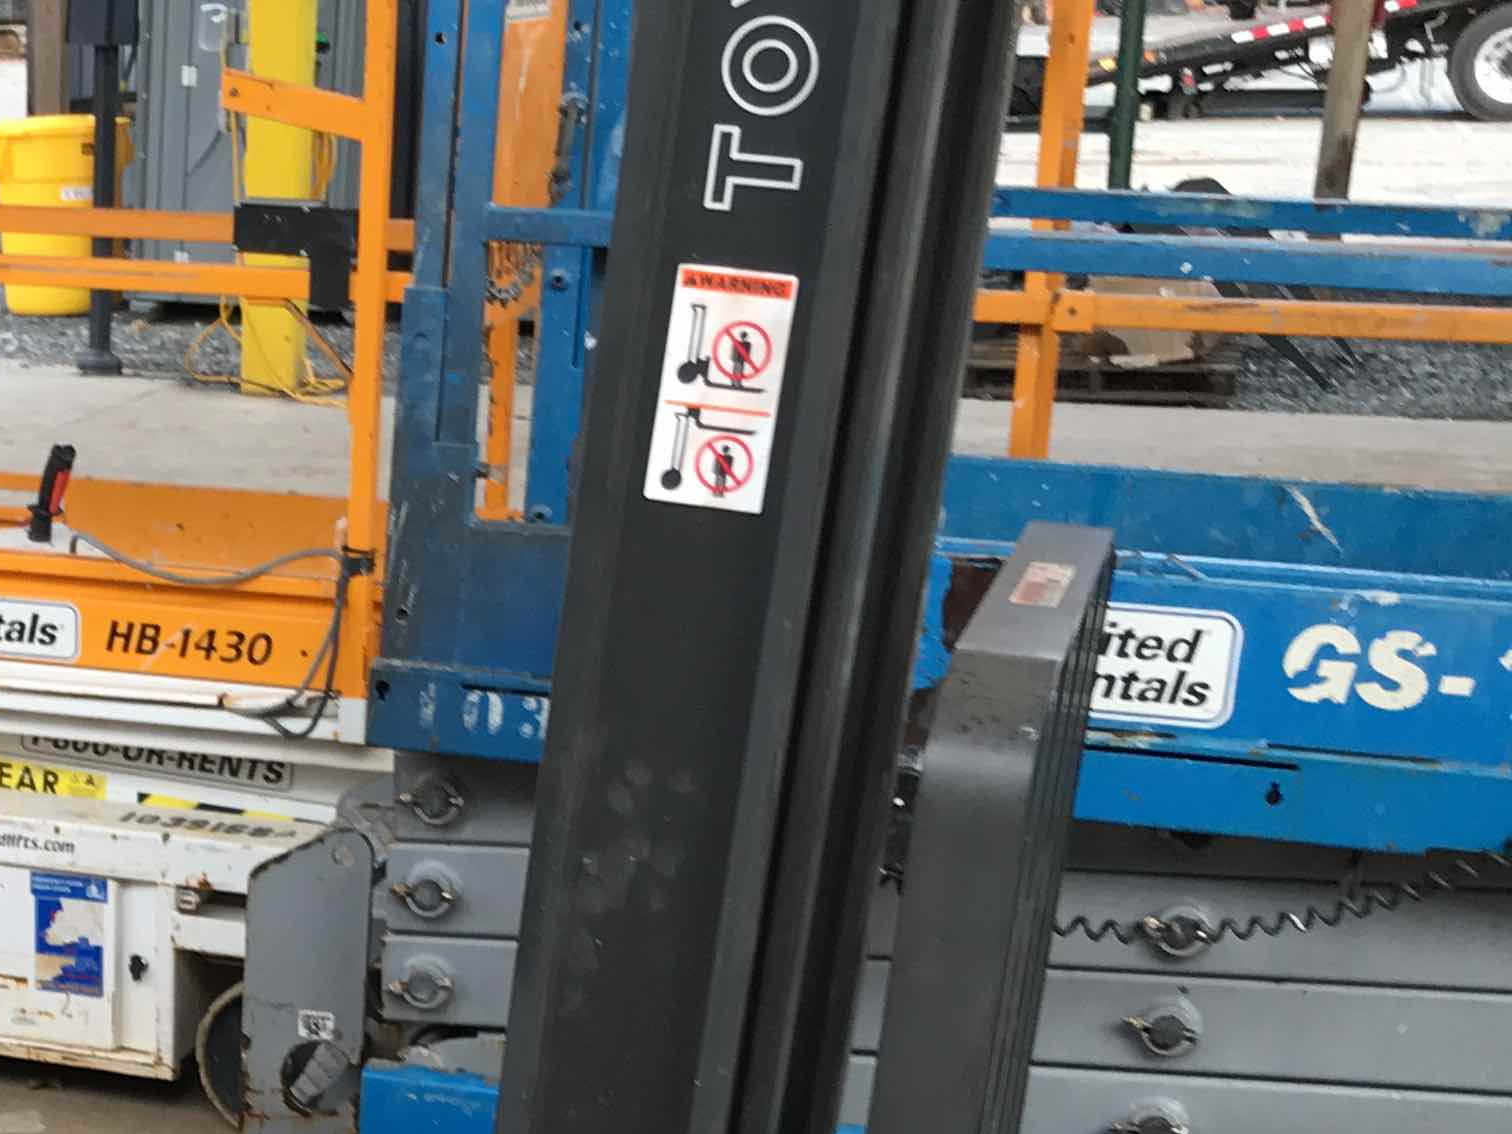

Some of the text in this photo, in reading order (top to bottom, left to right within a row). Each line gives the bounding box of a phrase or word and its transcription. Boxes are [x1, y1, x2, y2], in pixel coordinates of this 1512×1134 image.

[704, 0, 820, 211] TO
[105, 620, 273, 666] HB-1430
[1098, 621, 1205, 664] ited
[1093, 670, 1211, 707] ntals
[1282, 624, 1512, 711] GS-
